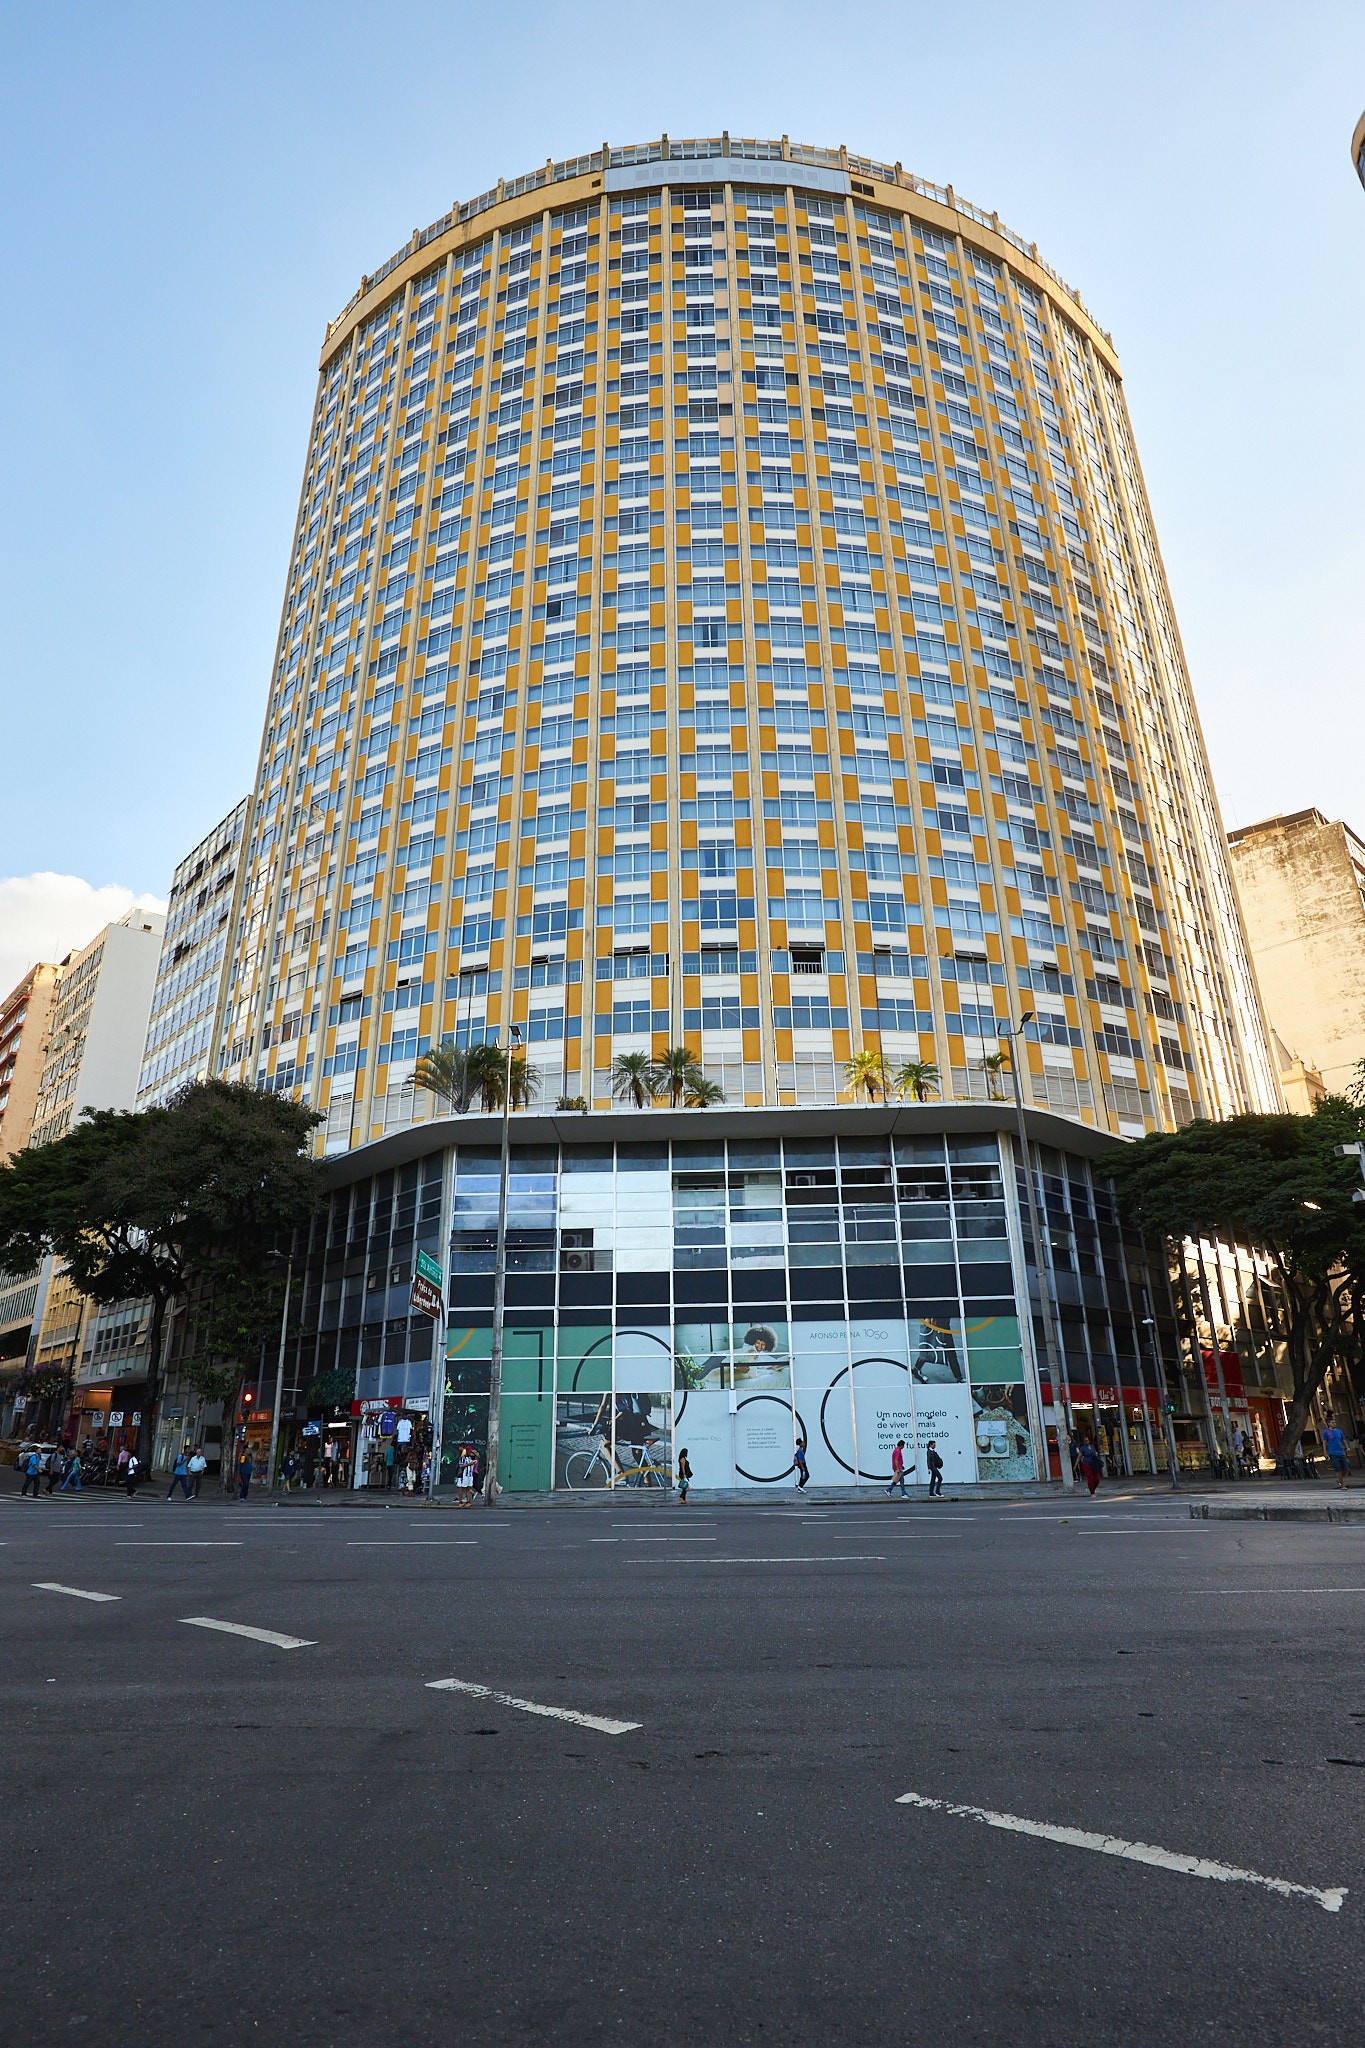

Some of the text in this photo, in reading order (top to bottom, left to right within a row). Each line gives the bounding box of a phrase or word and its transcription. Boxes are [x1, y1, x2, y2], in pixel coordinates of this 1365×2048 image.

[840, 1331, 860, 1339] PENA
[863, 1328, 888, 1340] 1050
[917, 1410, 947, 1418] modelo
